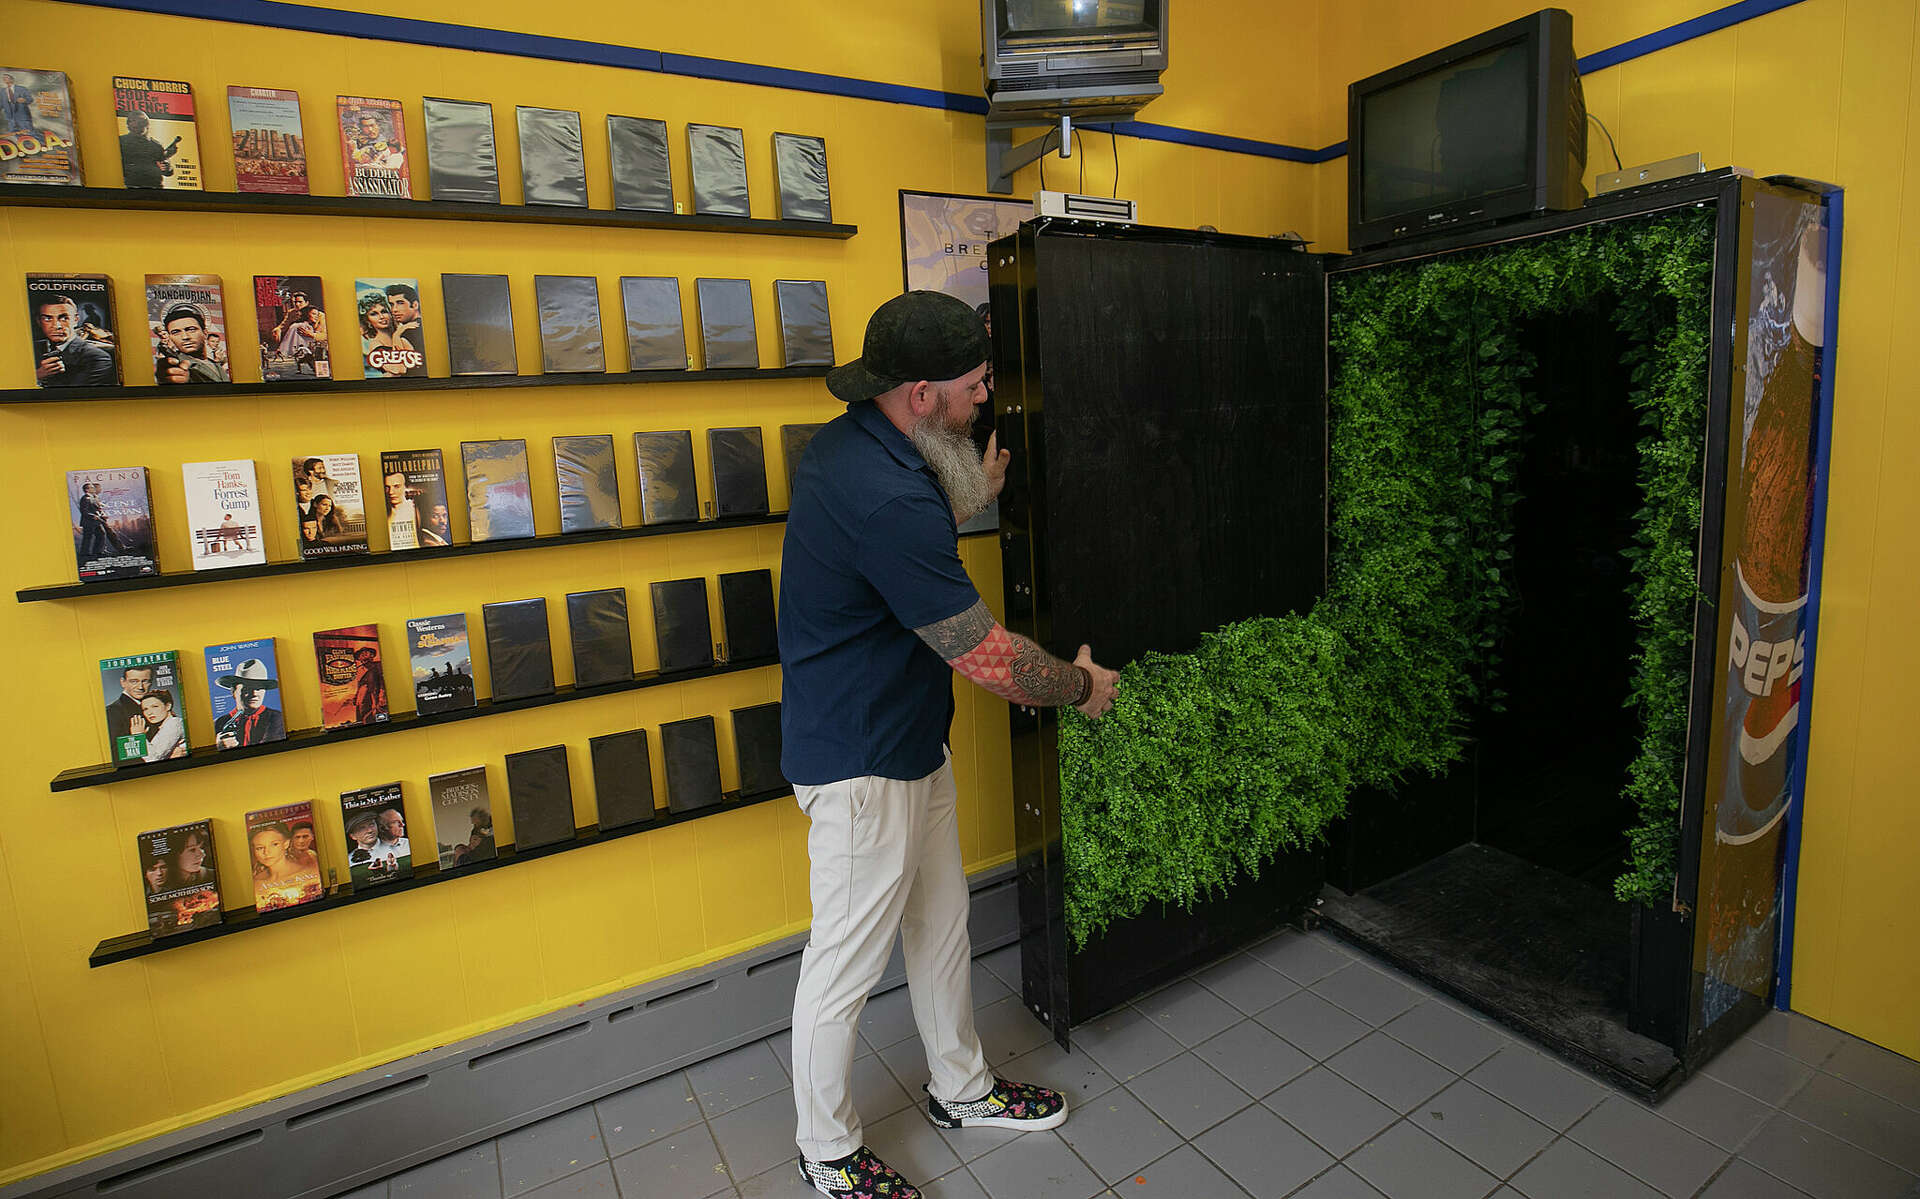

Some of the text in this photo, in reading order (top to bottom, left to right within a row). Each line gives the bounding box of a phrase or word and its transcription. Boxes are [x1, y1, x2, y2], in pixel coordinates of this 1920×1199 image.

[115, 79, 188, 94] CHUCK NORRIS
[115, 89, 150, 101] CODE
[117, 100, 169, 113] SILENCE
[355, 168, 399, 179] BUDDHA
[349, 177, 412, 199] ASSASSINATOR
[29, 283, 105, 291] GOLDFINGER
[154, 290, 211, 302] MANCHURIAN
[369, 350, 424, 368] GREASE
[383, 458, 441, 473] PHILADELPHIA
[73, 471, 140, 483] PACINO
[224, 472, 240, 481] Tom
[217, 481, 241, 489] Hanks
[213, 489, 248, 500] Forrest
[220, 499, 249, 511] Gump
[304, 543, 368, 556] GOOD WILL HUNTING
[407, 620, 431, 629] Classic
[416, 624, 445, 632] Westerns
[220, 645, 237, 653] JOHN
[107, 653, 169, 668] JOHN WAYNE
[211, 656, 230, 665] BLUE
[212, 663, 233, 672] STEEL
[344, 801, 360, 810] This
[367, 796, 378, 804] My
[379, 793, 402, 802] Father
[150, 895, 168, 904] SOME
[199, 884, 215, 893] SON
